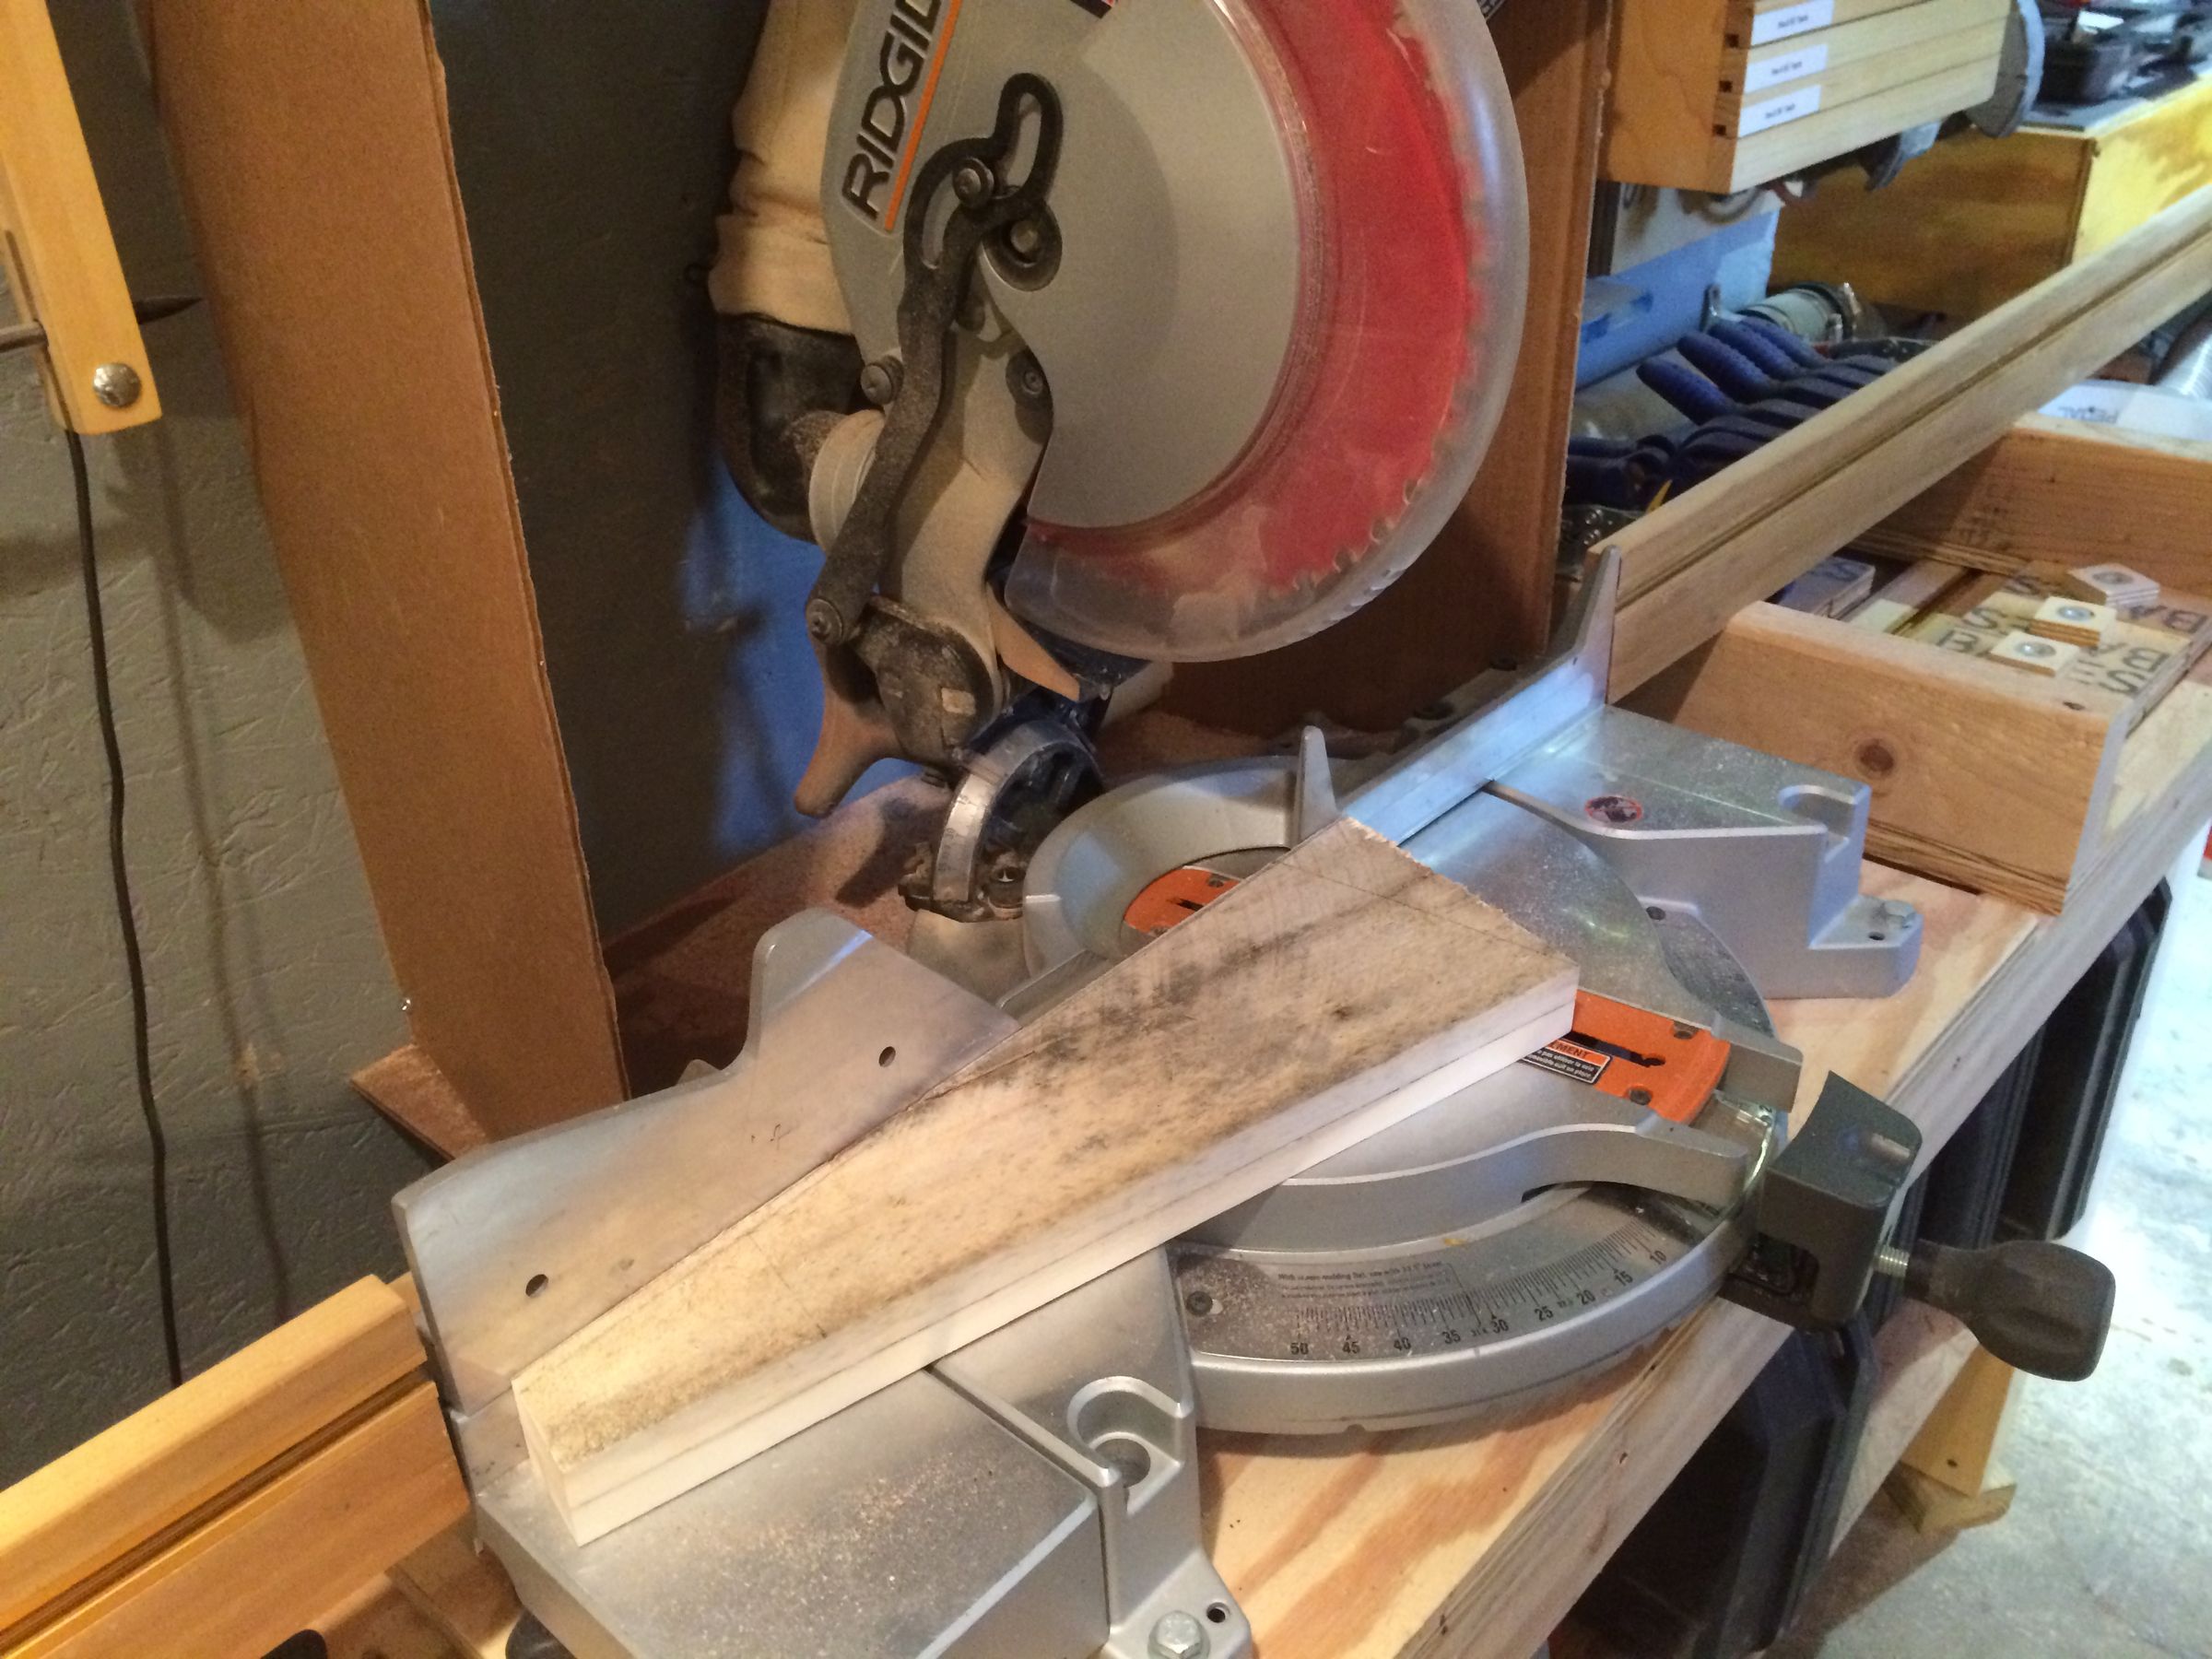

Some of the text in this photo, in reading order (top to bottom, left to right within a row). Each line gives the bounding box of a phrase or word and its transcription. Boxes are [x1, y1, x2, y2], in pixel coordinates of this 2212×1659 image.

[1290, 1342, 1309, 1355] 50
[1342, 1341, 1360, 1354] 45
[1394, 1336, 1411, 1351] 40
[1441, 1330, 1461, 1345] 35
[1491, 1319, 1509, 1334] 30
[1535, 1305, 1554, 1322] 25
[1576, 1289, 1595, 1305] 20
[1615, 1270, 1633, 1287] 15
[1650, 1250, 1666, 1265] 10
